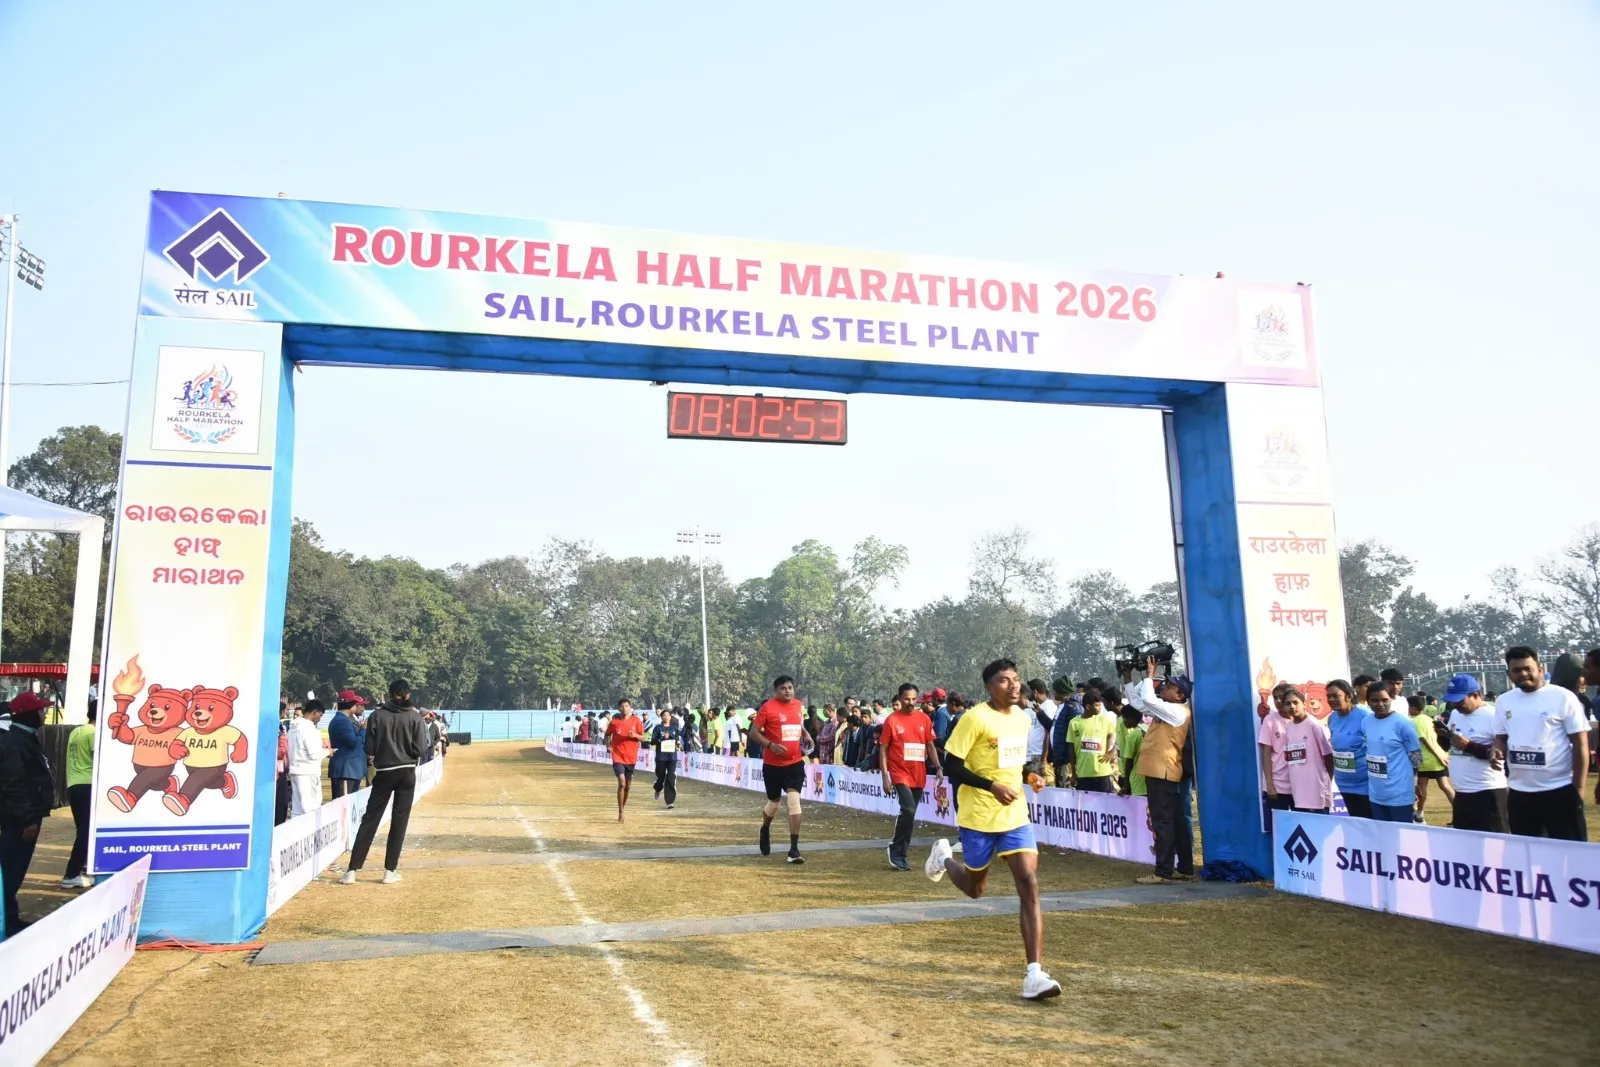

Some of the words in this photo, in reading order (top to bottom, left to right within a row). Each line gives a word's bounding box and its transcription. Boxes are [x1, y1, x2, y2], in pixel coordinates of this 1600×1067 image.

[332, 225, 617, 282] ROURKELA
[636, 249, 762, 292] HALF
[779, 262, 1039, 314] MARATHON
[1054, 280, 1157, 323] 2026
[174, 283, 209, 305] सेल
[216, 291, 255, 307] SAIL
[484, 292, 800, 339] SAIL,ROURKELA
[811, 315, 918, 347] STEEL
[928, 323, 1040, 355] PLANT
[178, 410, 231, 418] ROURKELA
[193, 417, 244, 425] MARATHON
[670, 393, 843, 440] 08:02:53
[1248, 531, 1328, 555] राउरकेला
[152, 567, 245, 586] ମାରାଥନ
[1269, 601, 1328, 627] मैराथन
[138, 738, 169, 749] PADMA
[188, 738, 218, 749] RAJA
[1516, 752, 1537, 762] 5417
[1043, 804, 1098, 834] MARATHON
[1100, 812, 1128, 839] 2026
[102, 846, 128, 854] SAIL,
[129, 844, 180, 854] ROURKELA
[181, 843, 209, 852] STEEL
[211, 842, 242, 851] PLANT
[1287, 865, 1300, 877] सेल
[1301, 870, 1316, 881] SAIL
[1335, 846, 1558, 904] SAIL,ROURKELA
[65, 929, 97, 983] STEEL
[99, 905, 128, 954] PLANT
